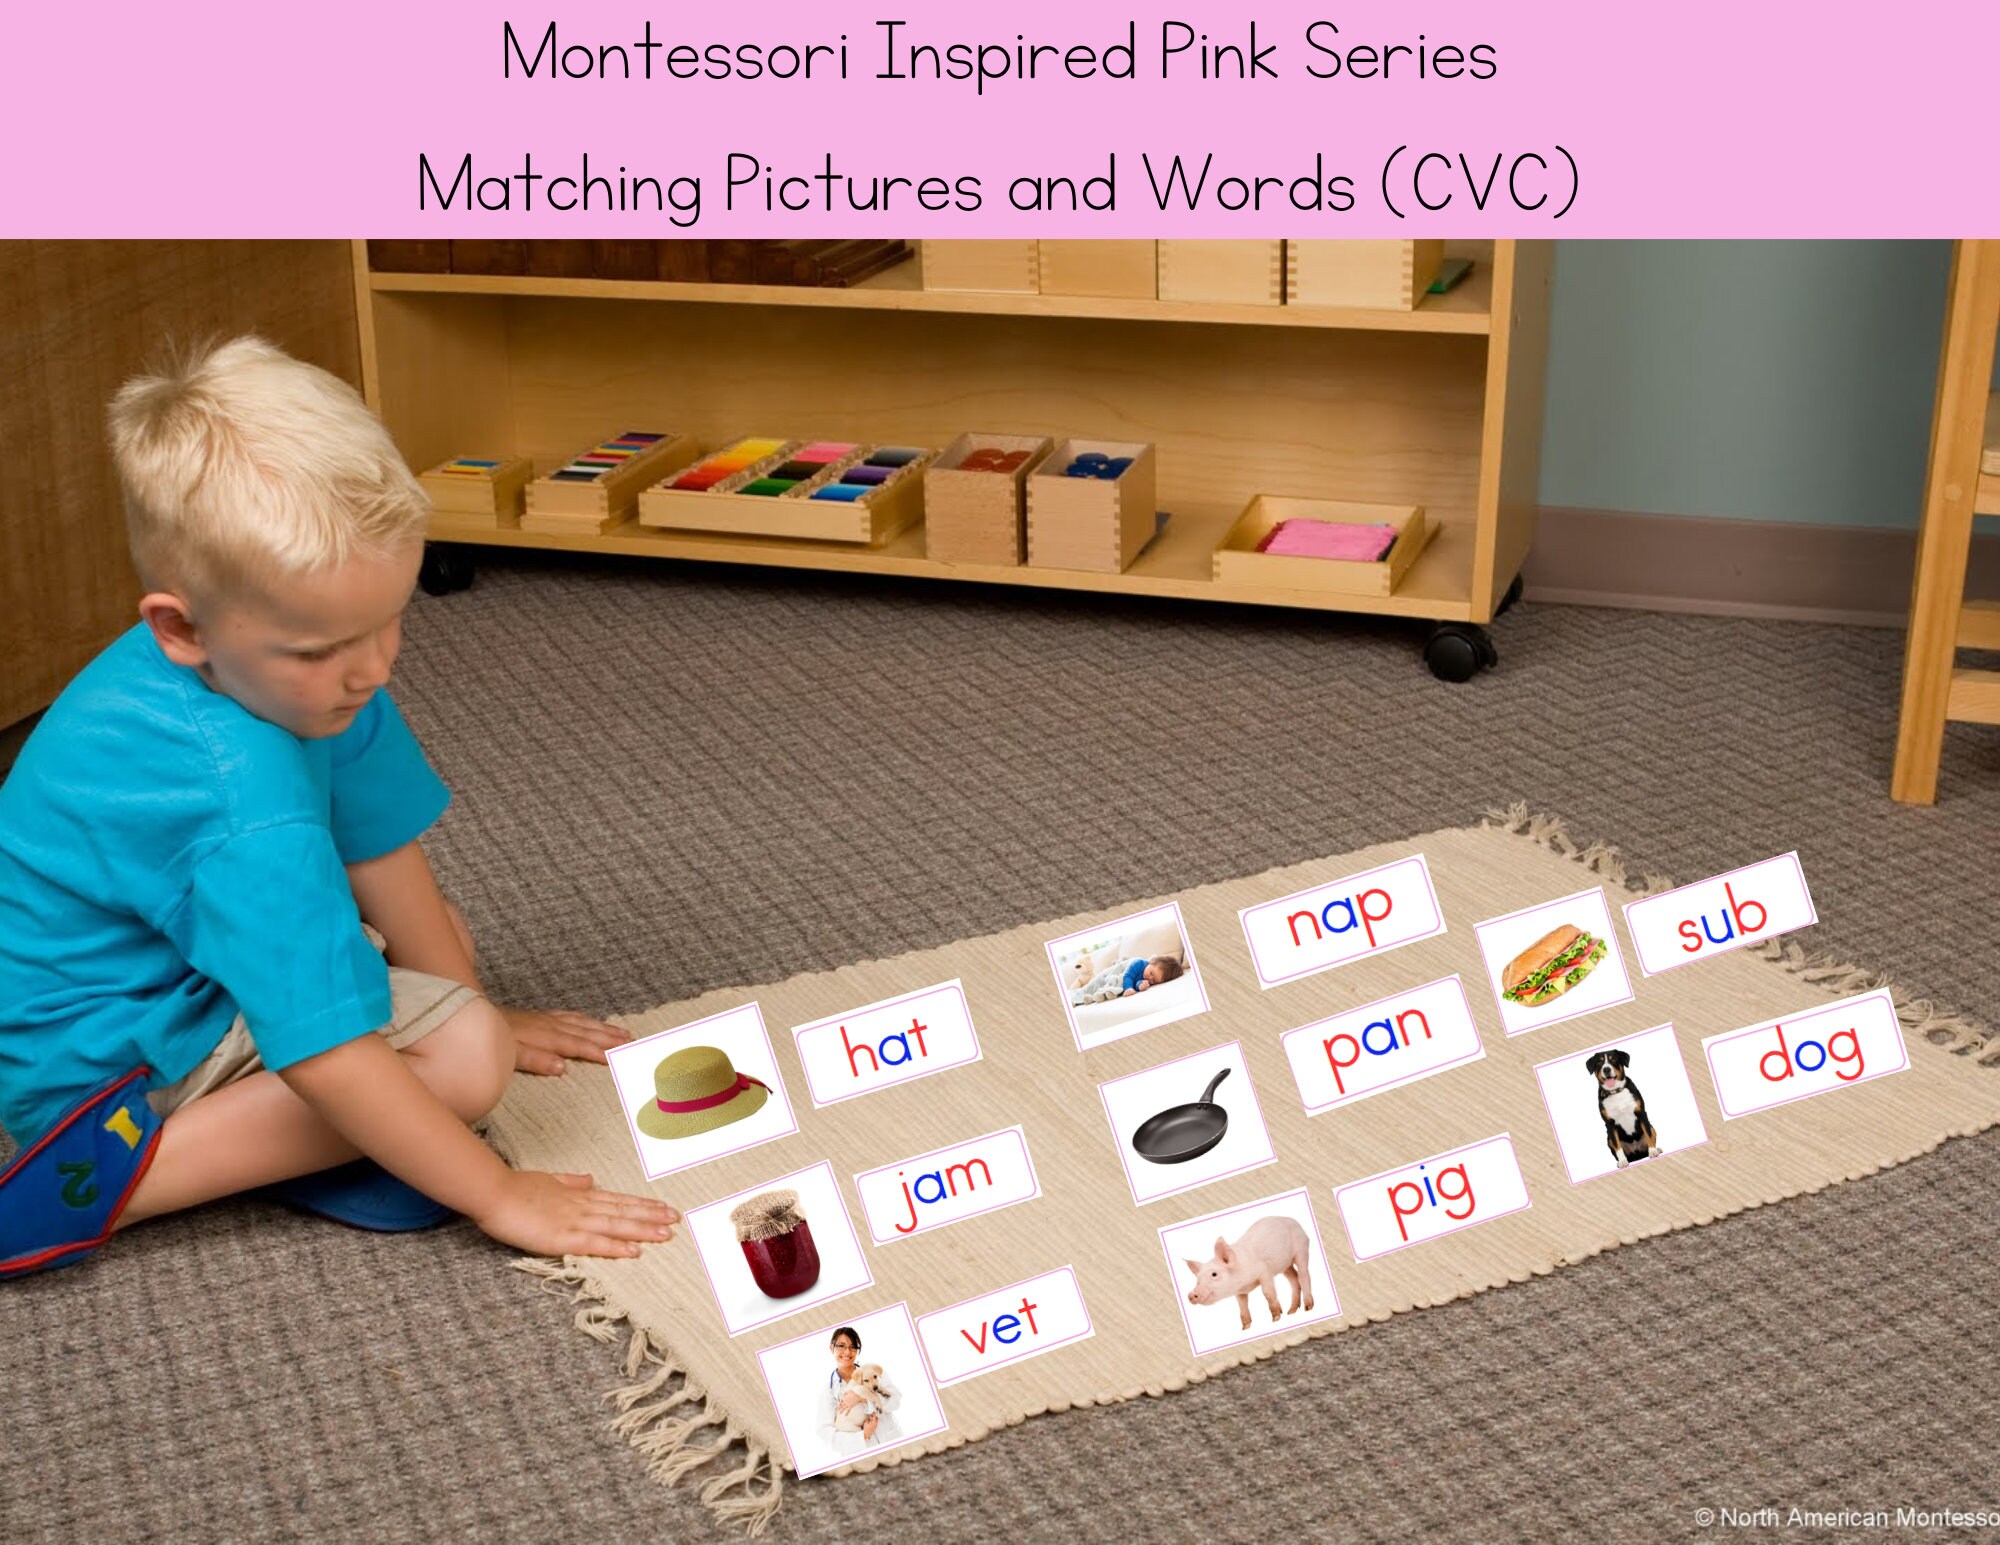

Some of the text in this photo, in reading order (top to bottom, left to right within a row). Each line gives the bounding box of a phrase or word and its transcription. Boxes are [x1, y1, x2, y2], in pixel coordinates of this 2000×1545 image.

[1287, 888, 1393, 948] nap
[1678, 882, 1767, 953] sub
[839, 1018, 927, 1077] hat
[1323, 1009, 1432, 1094] pan
[1759, 1024, 1865, 1082] dog
[58, 1161, 98, 1208] 2
[895, 1158, 993, 1233] jam
[1387, 1163, 1475, 1241] pig
[960, 1298, 1038, 1354] vet
